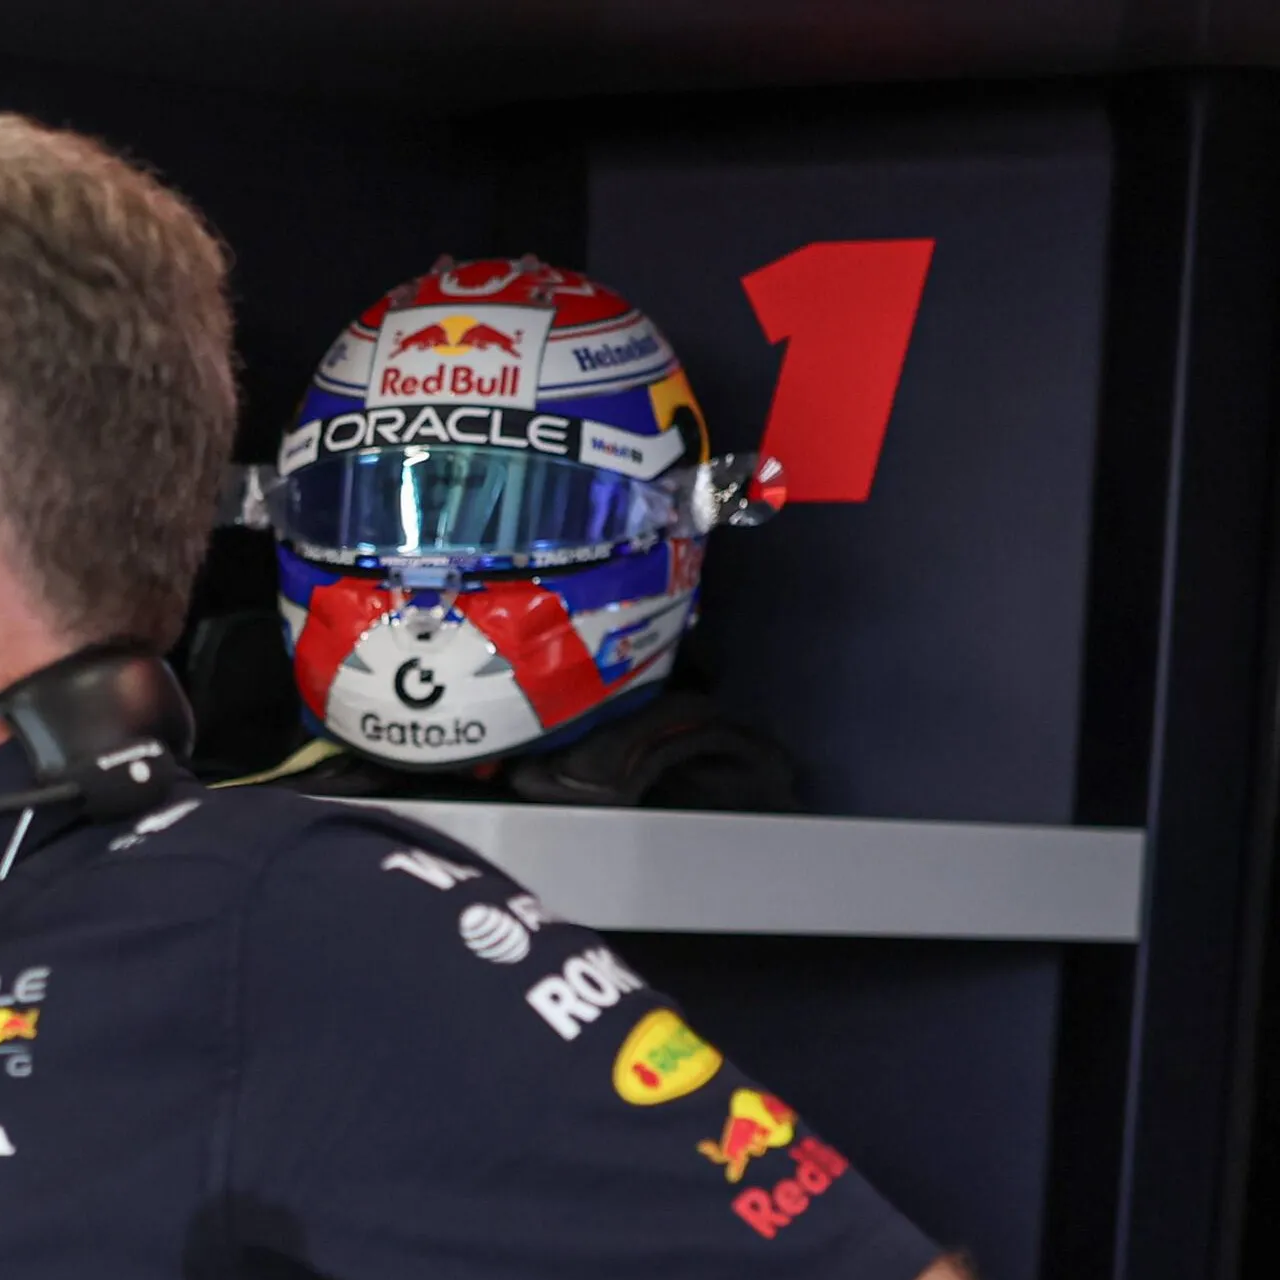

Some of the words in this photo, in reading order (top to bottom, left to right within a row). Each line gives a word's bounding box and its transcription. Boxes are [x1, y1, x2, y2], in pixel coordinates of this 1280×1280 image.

[380, 364, 444, 397] Red
[450, 366, 520, 398] Bull
[741, 238, 934, 502] 1
[324, 406, 570, 455] ORACLE
[361, 714, 486, 748] Gate.io
